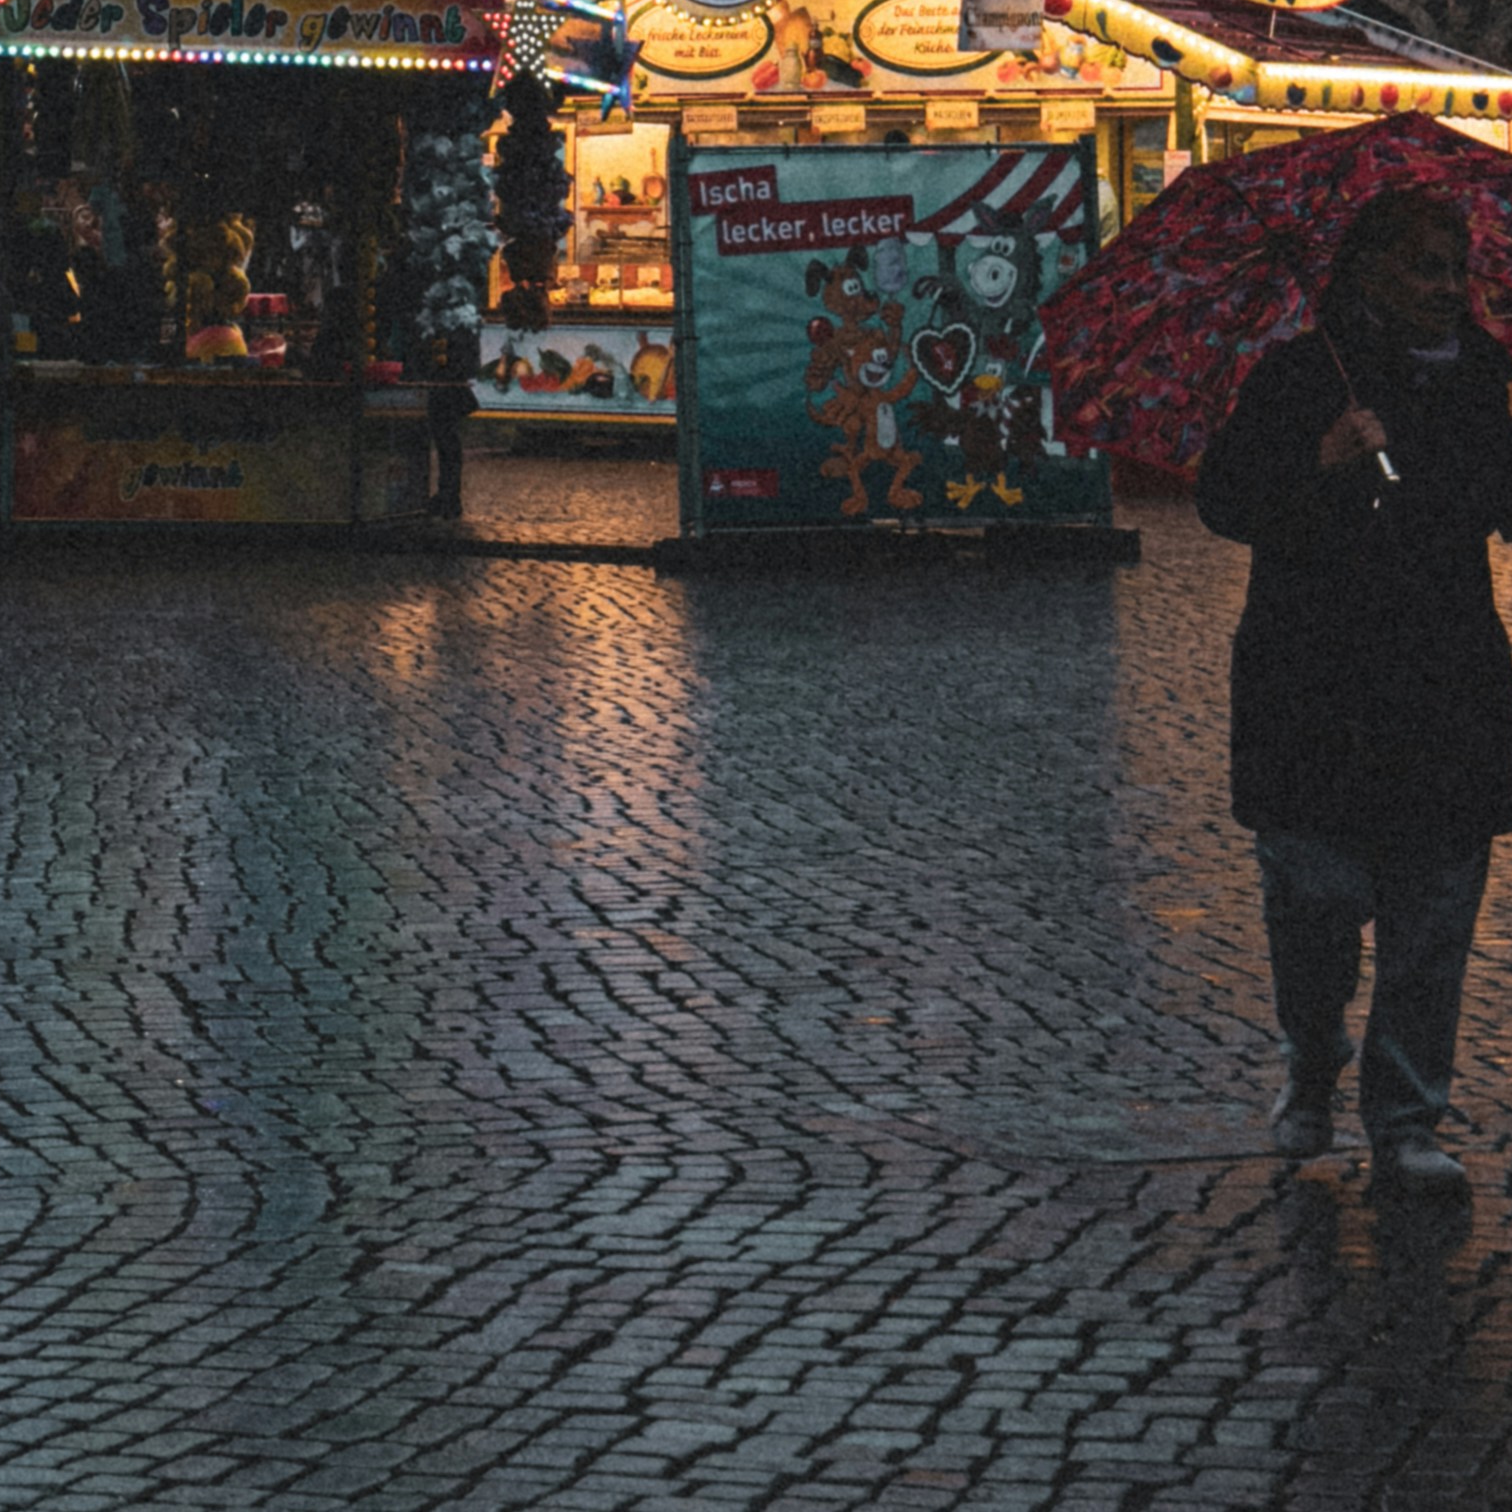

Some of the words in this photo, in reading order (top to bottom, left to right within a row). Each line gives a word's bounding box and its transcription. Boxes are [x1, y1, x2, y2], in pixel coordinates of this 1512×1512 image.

[300, 2, 468, 53] gewinnt
[698, 176, 773, 209] Ischa
[720, 211, 815, 246] lecker,
[821, 208, 906, 240] lecker
